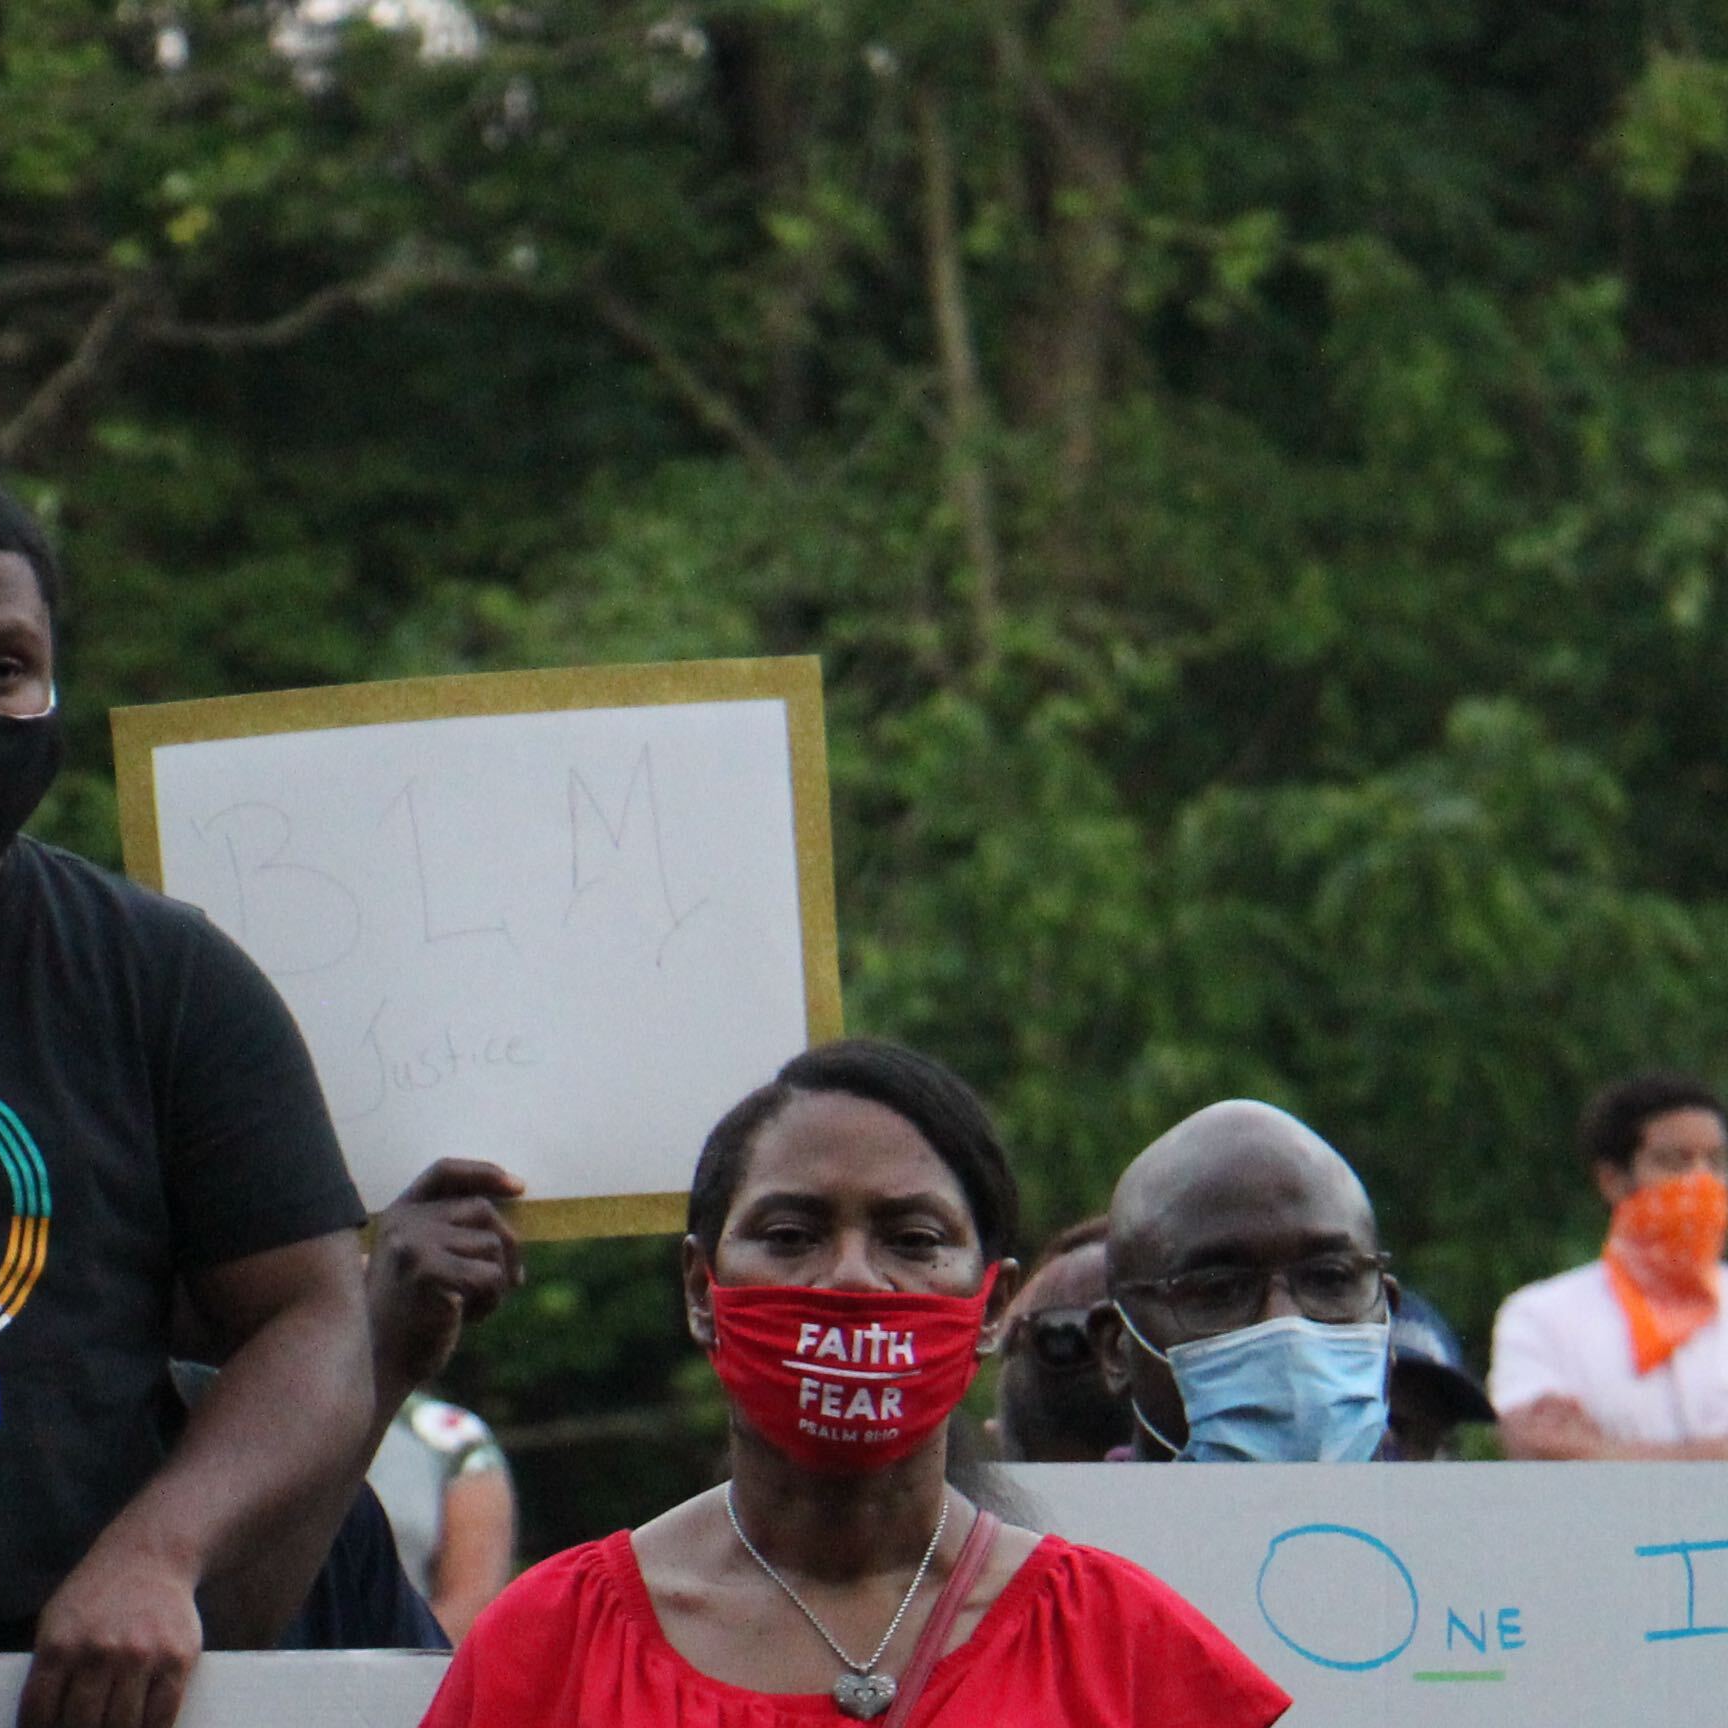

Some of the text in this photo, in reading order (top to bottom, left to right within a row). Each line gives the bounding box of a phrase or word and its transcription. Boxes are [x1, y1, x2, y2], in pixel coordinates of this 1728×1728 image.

[193, 740, 711, 976] BLM
[796, 1322, 915, 1365] FAITH
[799, 1377, 904, 1421] FEAR
[799, 1418, 858, 1442] PSALM
